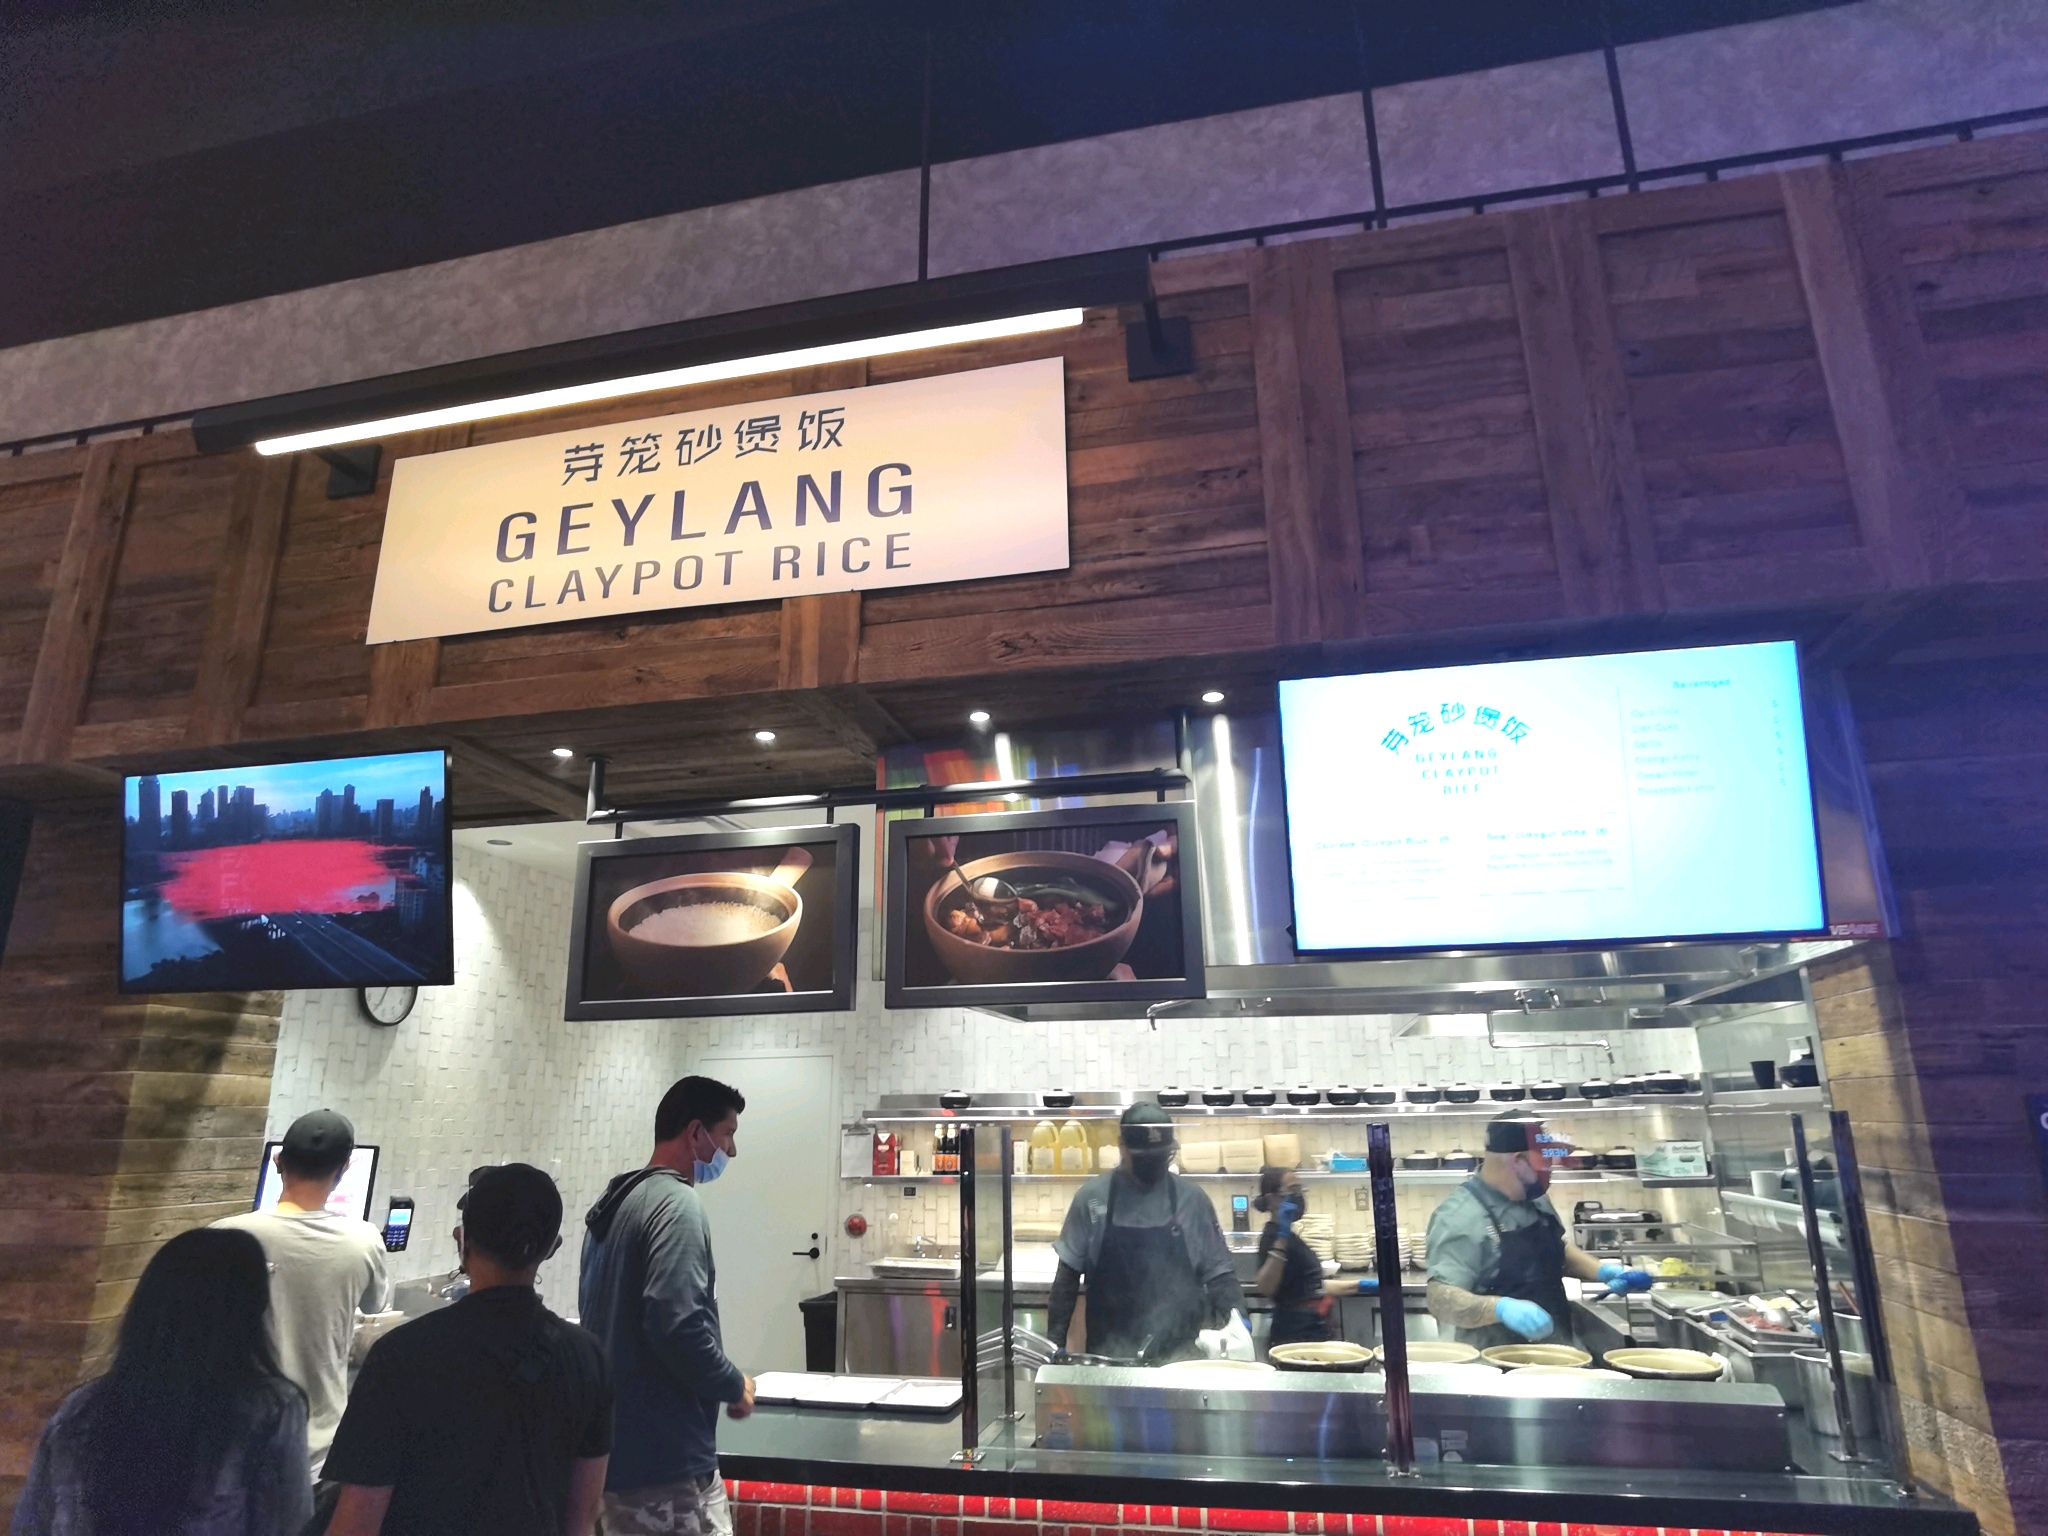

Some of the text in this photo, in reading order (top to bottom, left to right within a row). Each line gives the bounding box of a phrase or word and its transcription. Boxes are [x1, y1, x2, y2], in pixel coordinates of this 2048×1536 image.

[561, 406, 847, 486] 芽笼砂煲饭
[495, 461, 915, 564] GEYLANG
[487, 531, 913, 615] CLAYPOT RICE
[1380, 701, 1532, 755] 芽笼砂煲饭
[1415, 747, 1499, 764] GEYLANG
[1421, 766, 1500, 780] CLAYPOT
[1442, 782, 1482, 795] RICE
